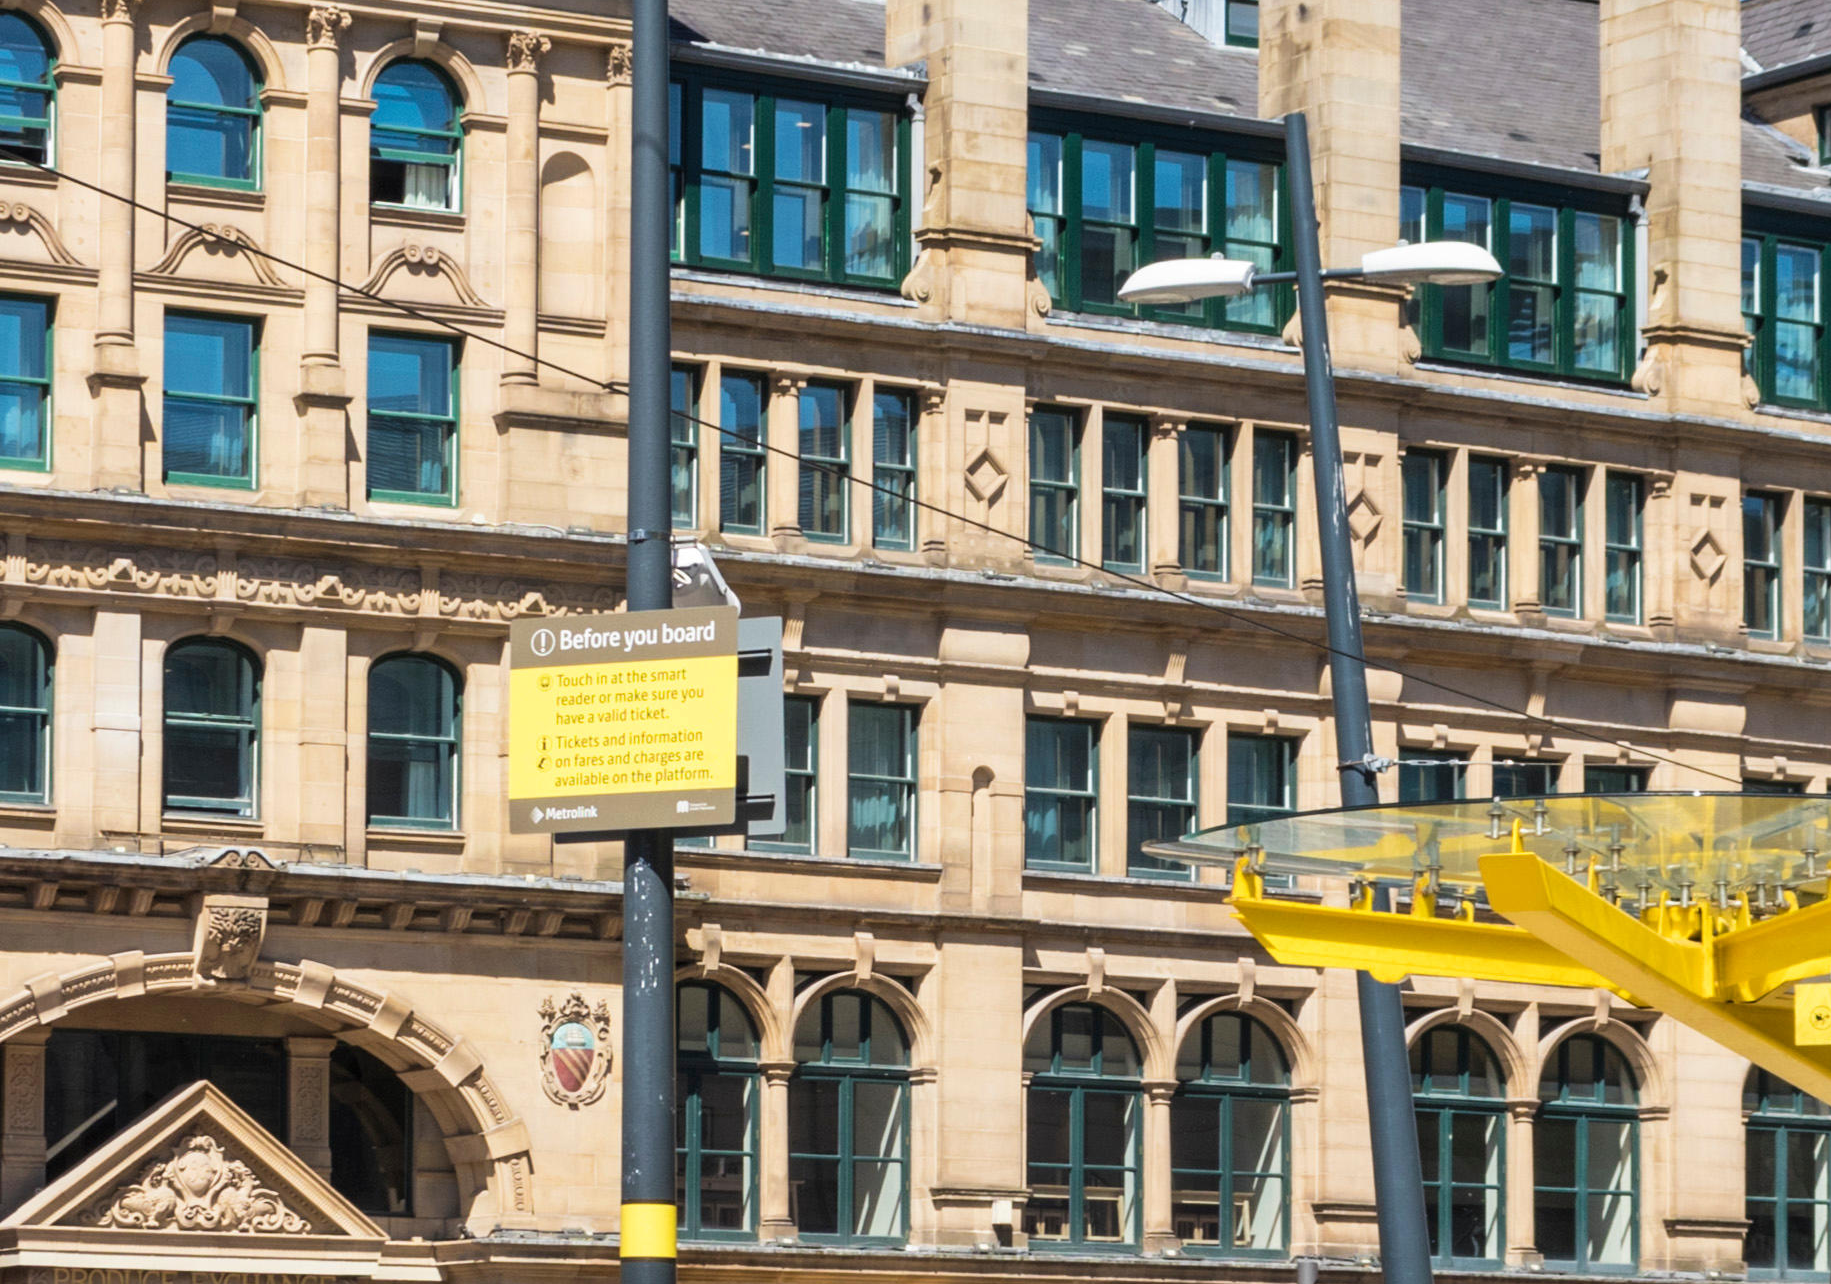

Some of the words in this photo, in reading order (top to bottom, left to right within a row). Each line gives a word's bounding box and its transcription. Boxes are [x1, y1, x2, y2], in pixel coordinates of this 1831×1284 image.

[560, 628, 620, 651] Before
[624, 629, 657, 652] you
[662, 621, 715, 645] board
[557, 674, 592, 688] Touch
[596, 672, 607, 685] in
[611, 673, 623, 684] at
[627, 671, 647, 684] the
[650, 668, 687, 683] smart
[556, 693, 596, 707] reader
[600, 693, 612, 704] or
[615, 689, 648, 702] make
[651, 689, 678, 700] sure
[681, 687, 704, 703] you
[556, 711, 584, 726] have
[588, 714, 594, 724] a
[598, 708, 627, 722] valid
[630, 708, 670, 721] ticket.
[557, 735, 600, 750] Tickets
[603, 732, 626, 747] and
[629, 729, 703, 745] information
[555, 756, 571, 768] on
[574, 753, 604, 767] fares
[608, 751, 630, 765] and
[634, 749, 681, 766] charges
[684, 750, 704, 761] are
[554, 771, 609, 788] available
[612, 772, 627, 784] on
[631, 769, 652, 783] the
[655, 766, 713, 785] platform.
[546, 806, 598, 821] Metrolink
